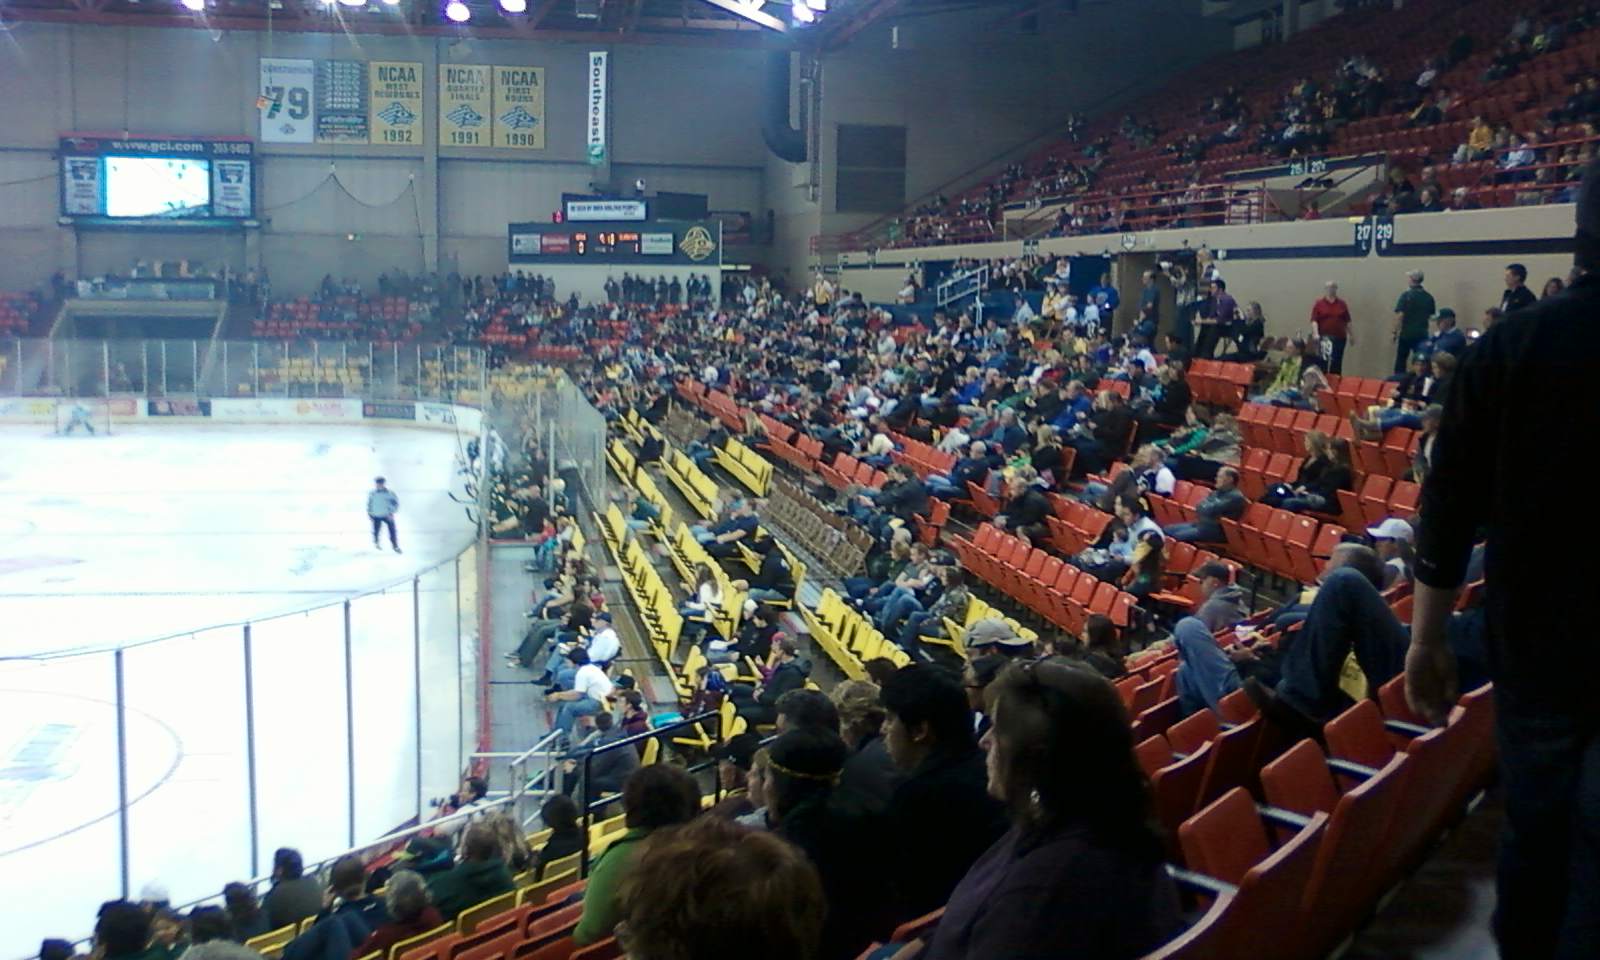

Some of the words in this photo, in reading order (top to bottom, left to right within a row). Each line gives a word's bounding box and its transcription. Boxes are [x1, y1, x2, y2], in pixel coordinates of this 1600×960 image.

[378, 66, 416, 82] NCAA
[447, 69, 485, 84] NCAA
[501, 71, 538, 86] NCAA
[591, 56, 603, 143] Southeast
[383, 129, 413, 142] 1992
[451, 132, 479, 145] 1991
[506, 134, 534, 146] 1990
[111, 141, 204, 154] www.gci.com
[1357, 223, 1371, 240] 217
[1377, 221, 1393, 240] 219
